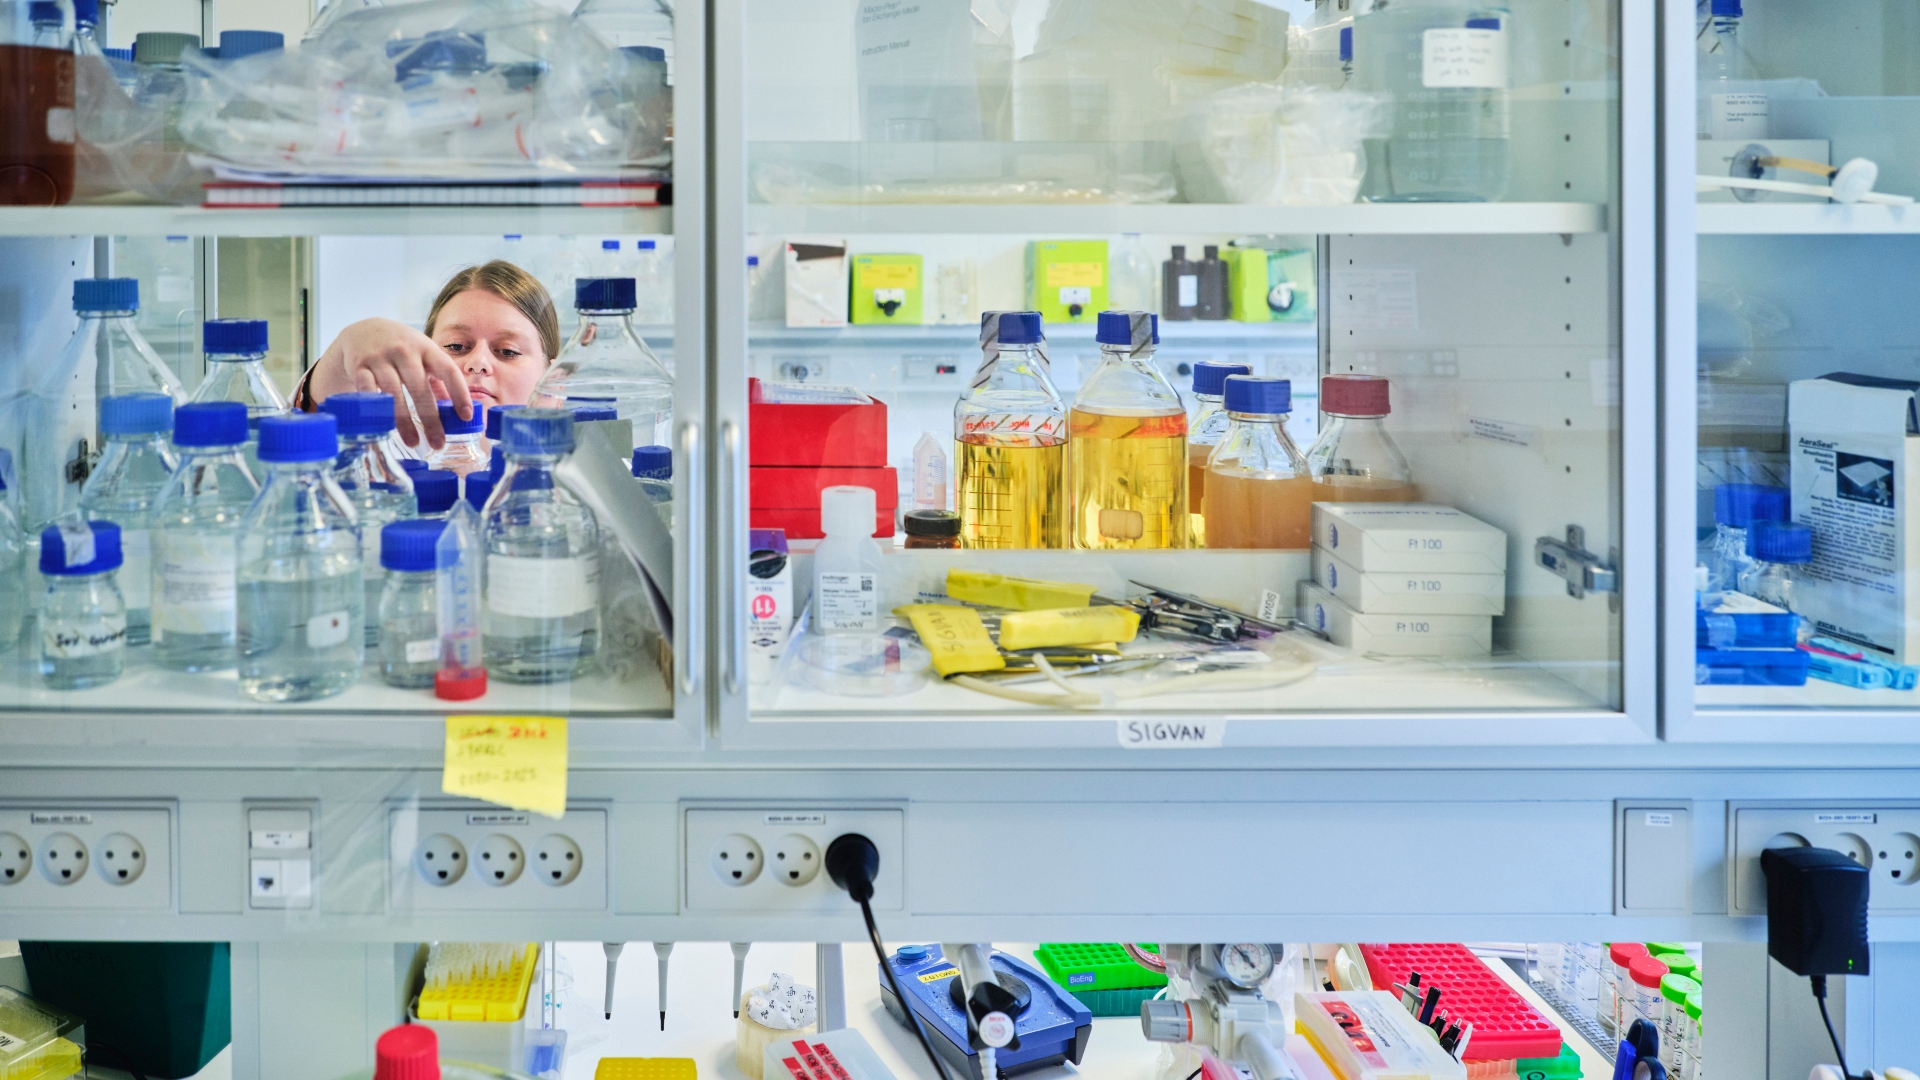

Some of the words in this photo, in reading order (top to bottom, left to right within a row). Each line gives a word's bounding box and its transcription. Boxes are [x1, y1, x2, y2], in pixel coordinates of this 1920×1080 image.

[1422, 539, 1442, 549] 100
[1421, 581, 1441, 591] 100
[1410, 622, 1430, 633] 100
[1128, 721, 1206, 743] SIGVAN
[1070, 974, 1093, 985] BioEng
